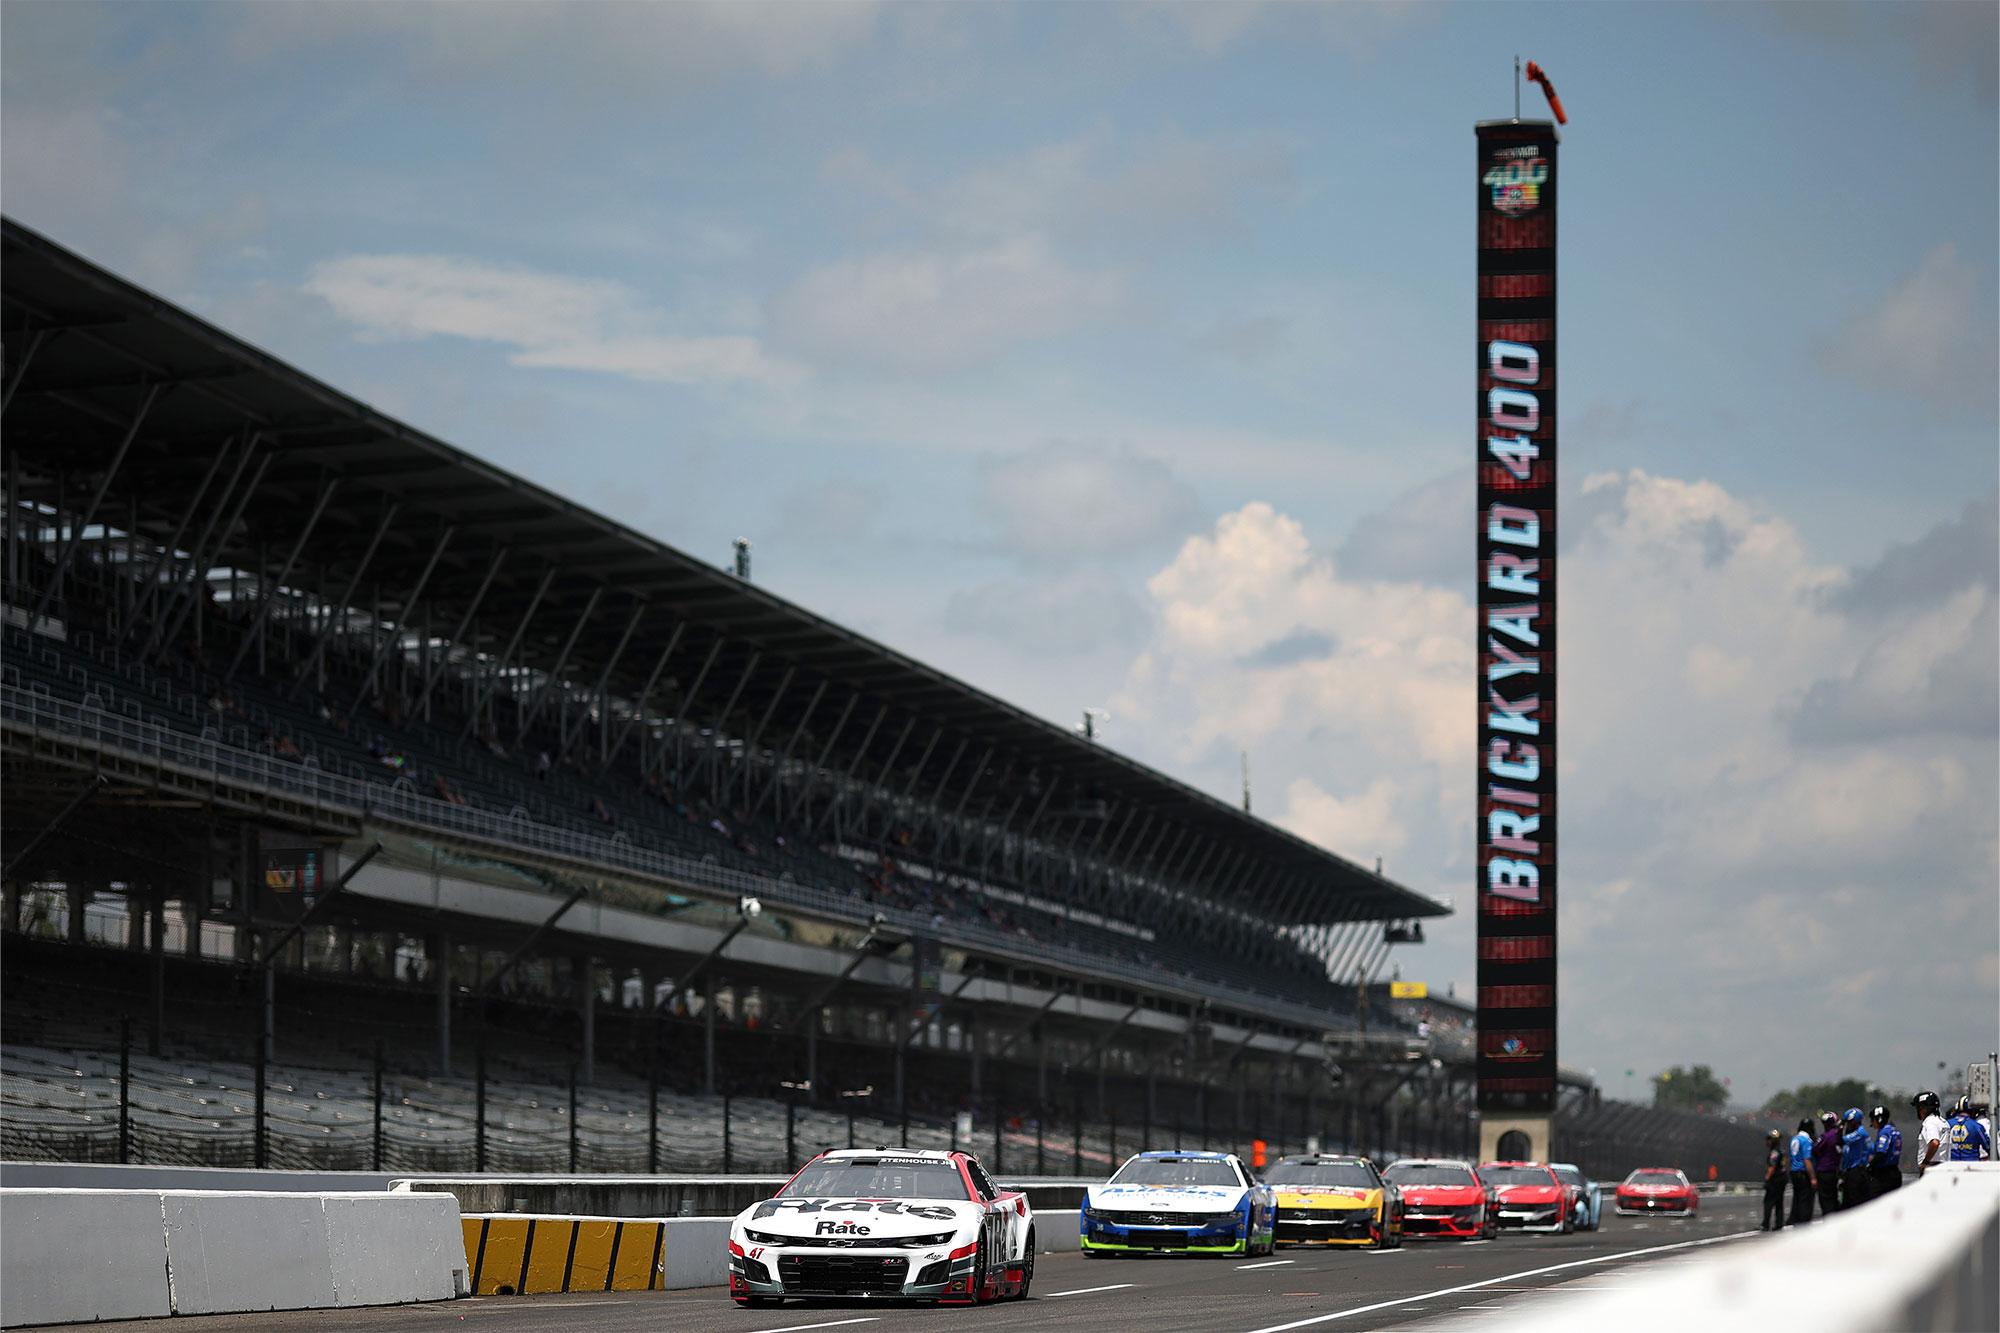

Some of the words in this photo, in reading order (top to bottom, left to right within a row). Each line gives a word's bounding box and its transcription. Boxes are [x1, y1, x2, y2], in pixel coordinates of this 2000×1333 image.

[1488, 339, 1541, 481] 400
[1488, 501, 1541, 903] BRICKYARD
[880, 1157, 939, 1166] STENHOUSE
[815, 1220, 871, 1236] Rate
[749, 1247, 765, 1260] 47
